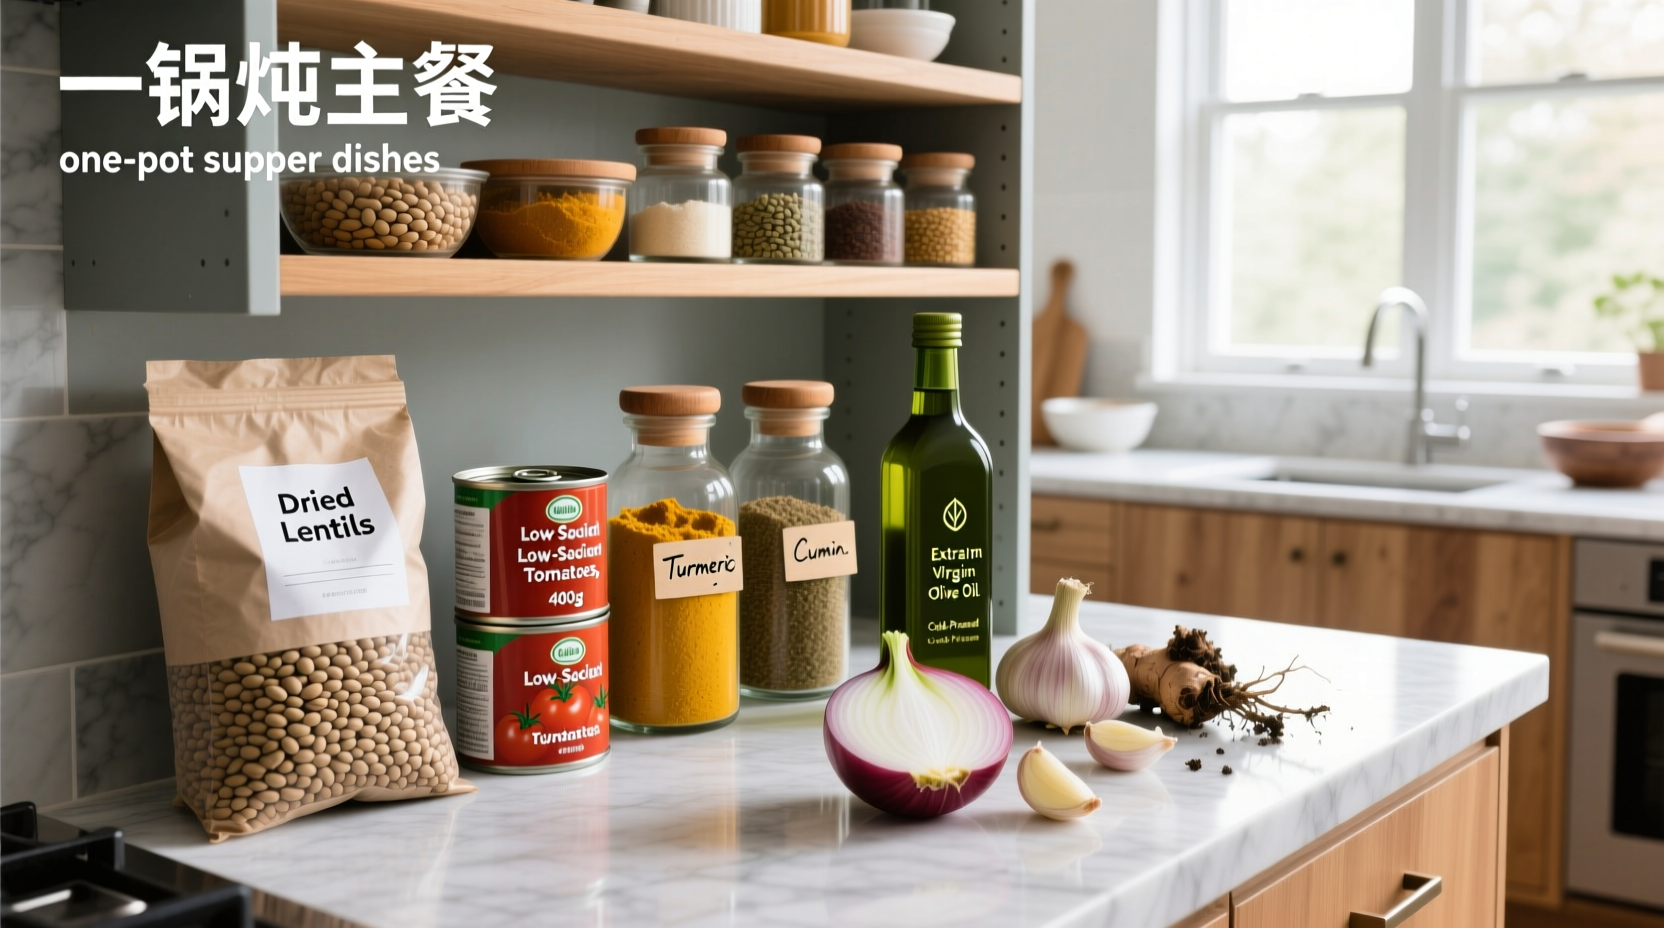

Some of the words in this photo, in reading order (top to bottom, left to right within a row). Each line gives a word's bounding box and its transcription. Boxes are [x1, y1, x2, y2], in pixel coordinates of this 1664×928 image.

[277, 486, 355, 515] Dried
[280, 513, 375, 543] Lentils
[520, 526, 555, 542] Low
[662, 554, 736, 580] Turmeric
[548, 590, 584, 607] 400g
[523, 671, 557, 687] Low
